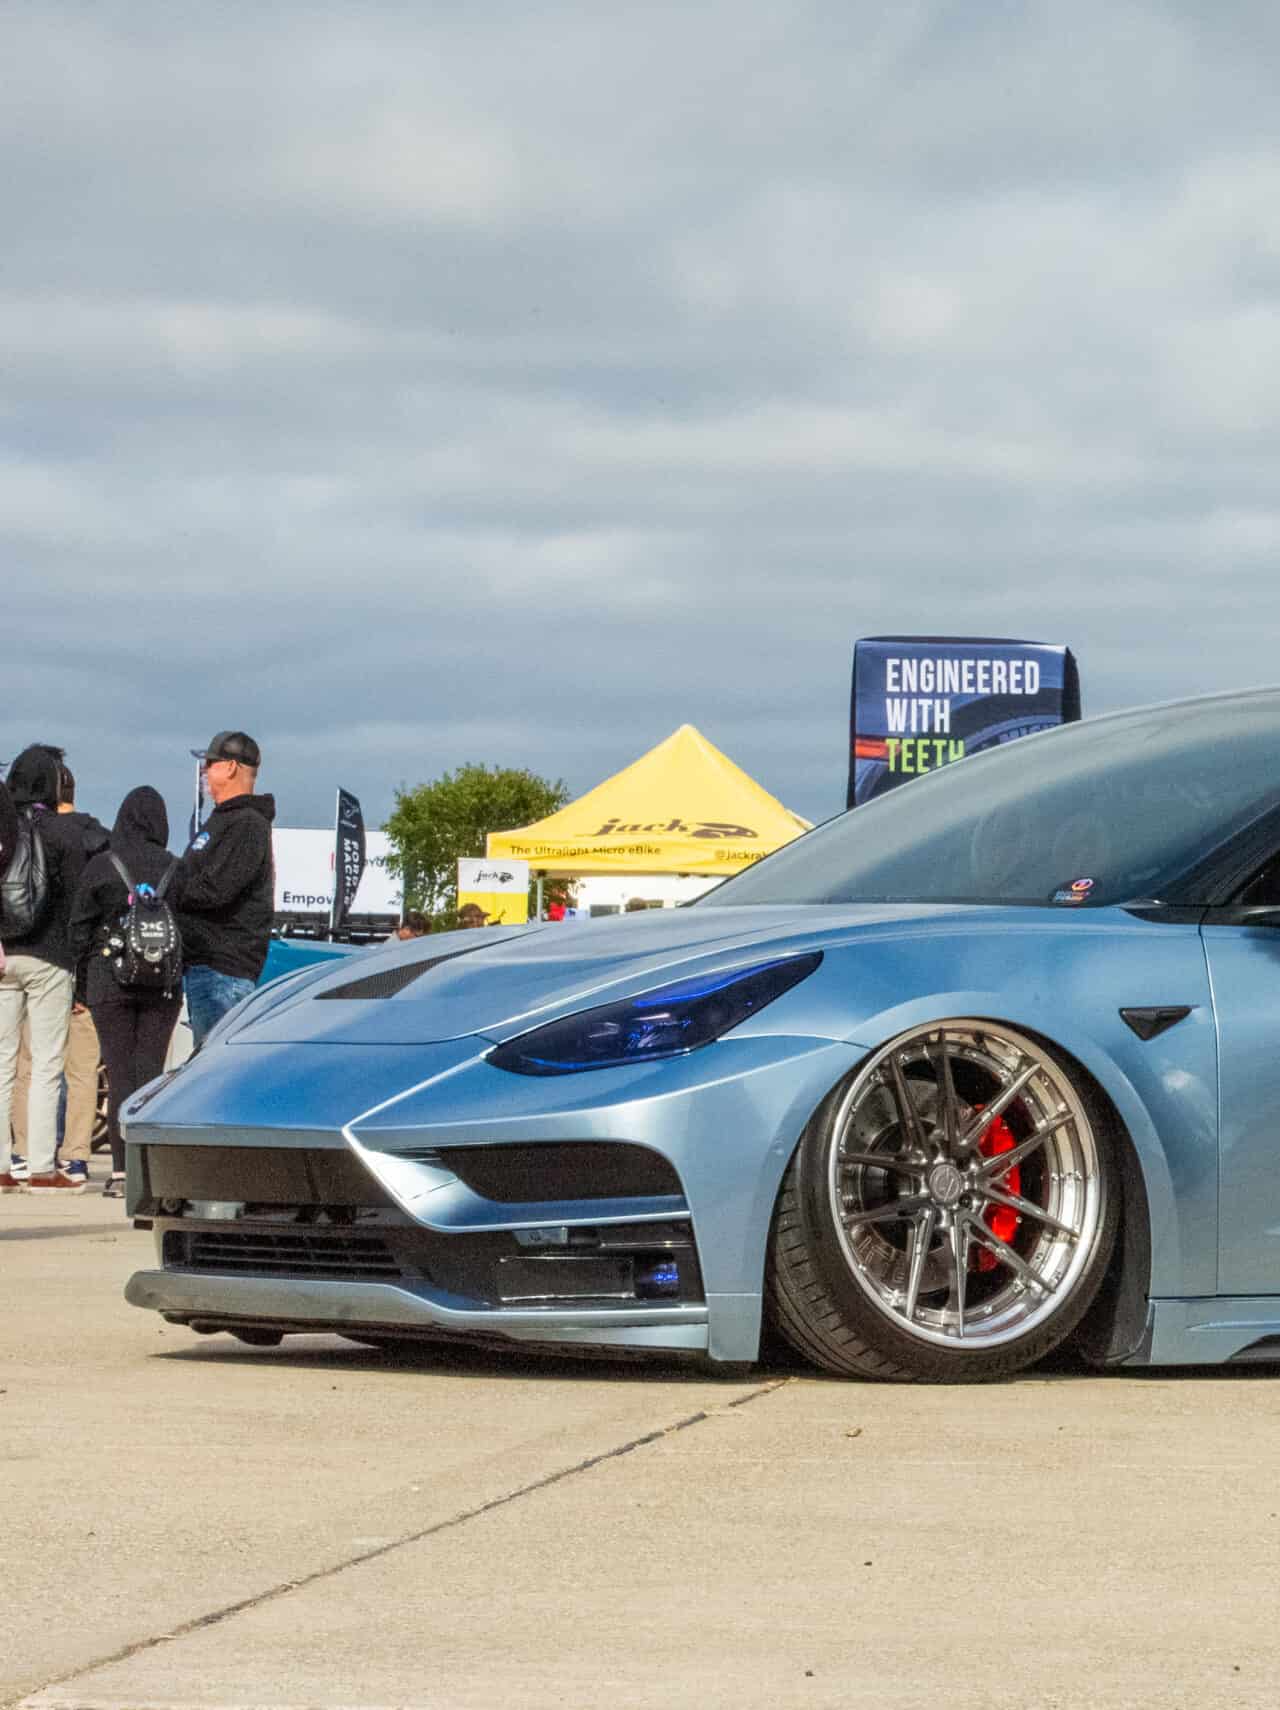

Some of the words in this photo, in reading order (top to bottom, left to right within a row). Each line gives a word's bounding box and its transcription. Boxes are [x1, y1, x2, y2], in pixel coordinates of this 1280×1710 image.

[885, 658, 1041, 695] ENGINEERED
[885, 698, 951, 734] WITH
[350, 840, 361, 887] FORD
[510, 845, 532, 856] The
